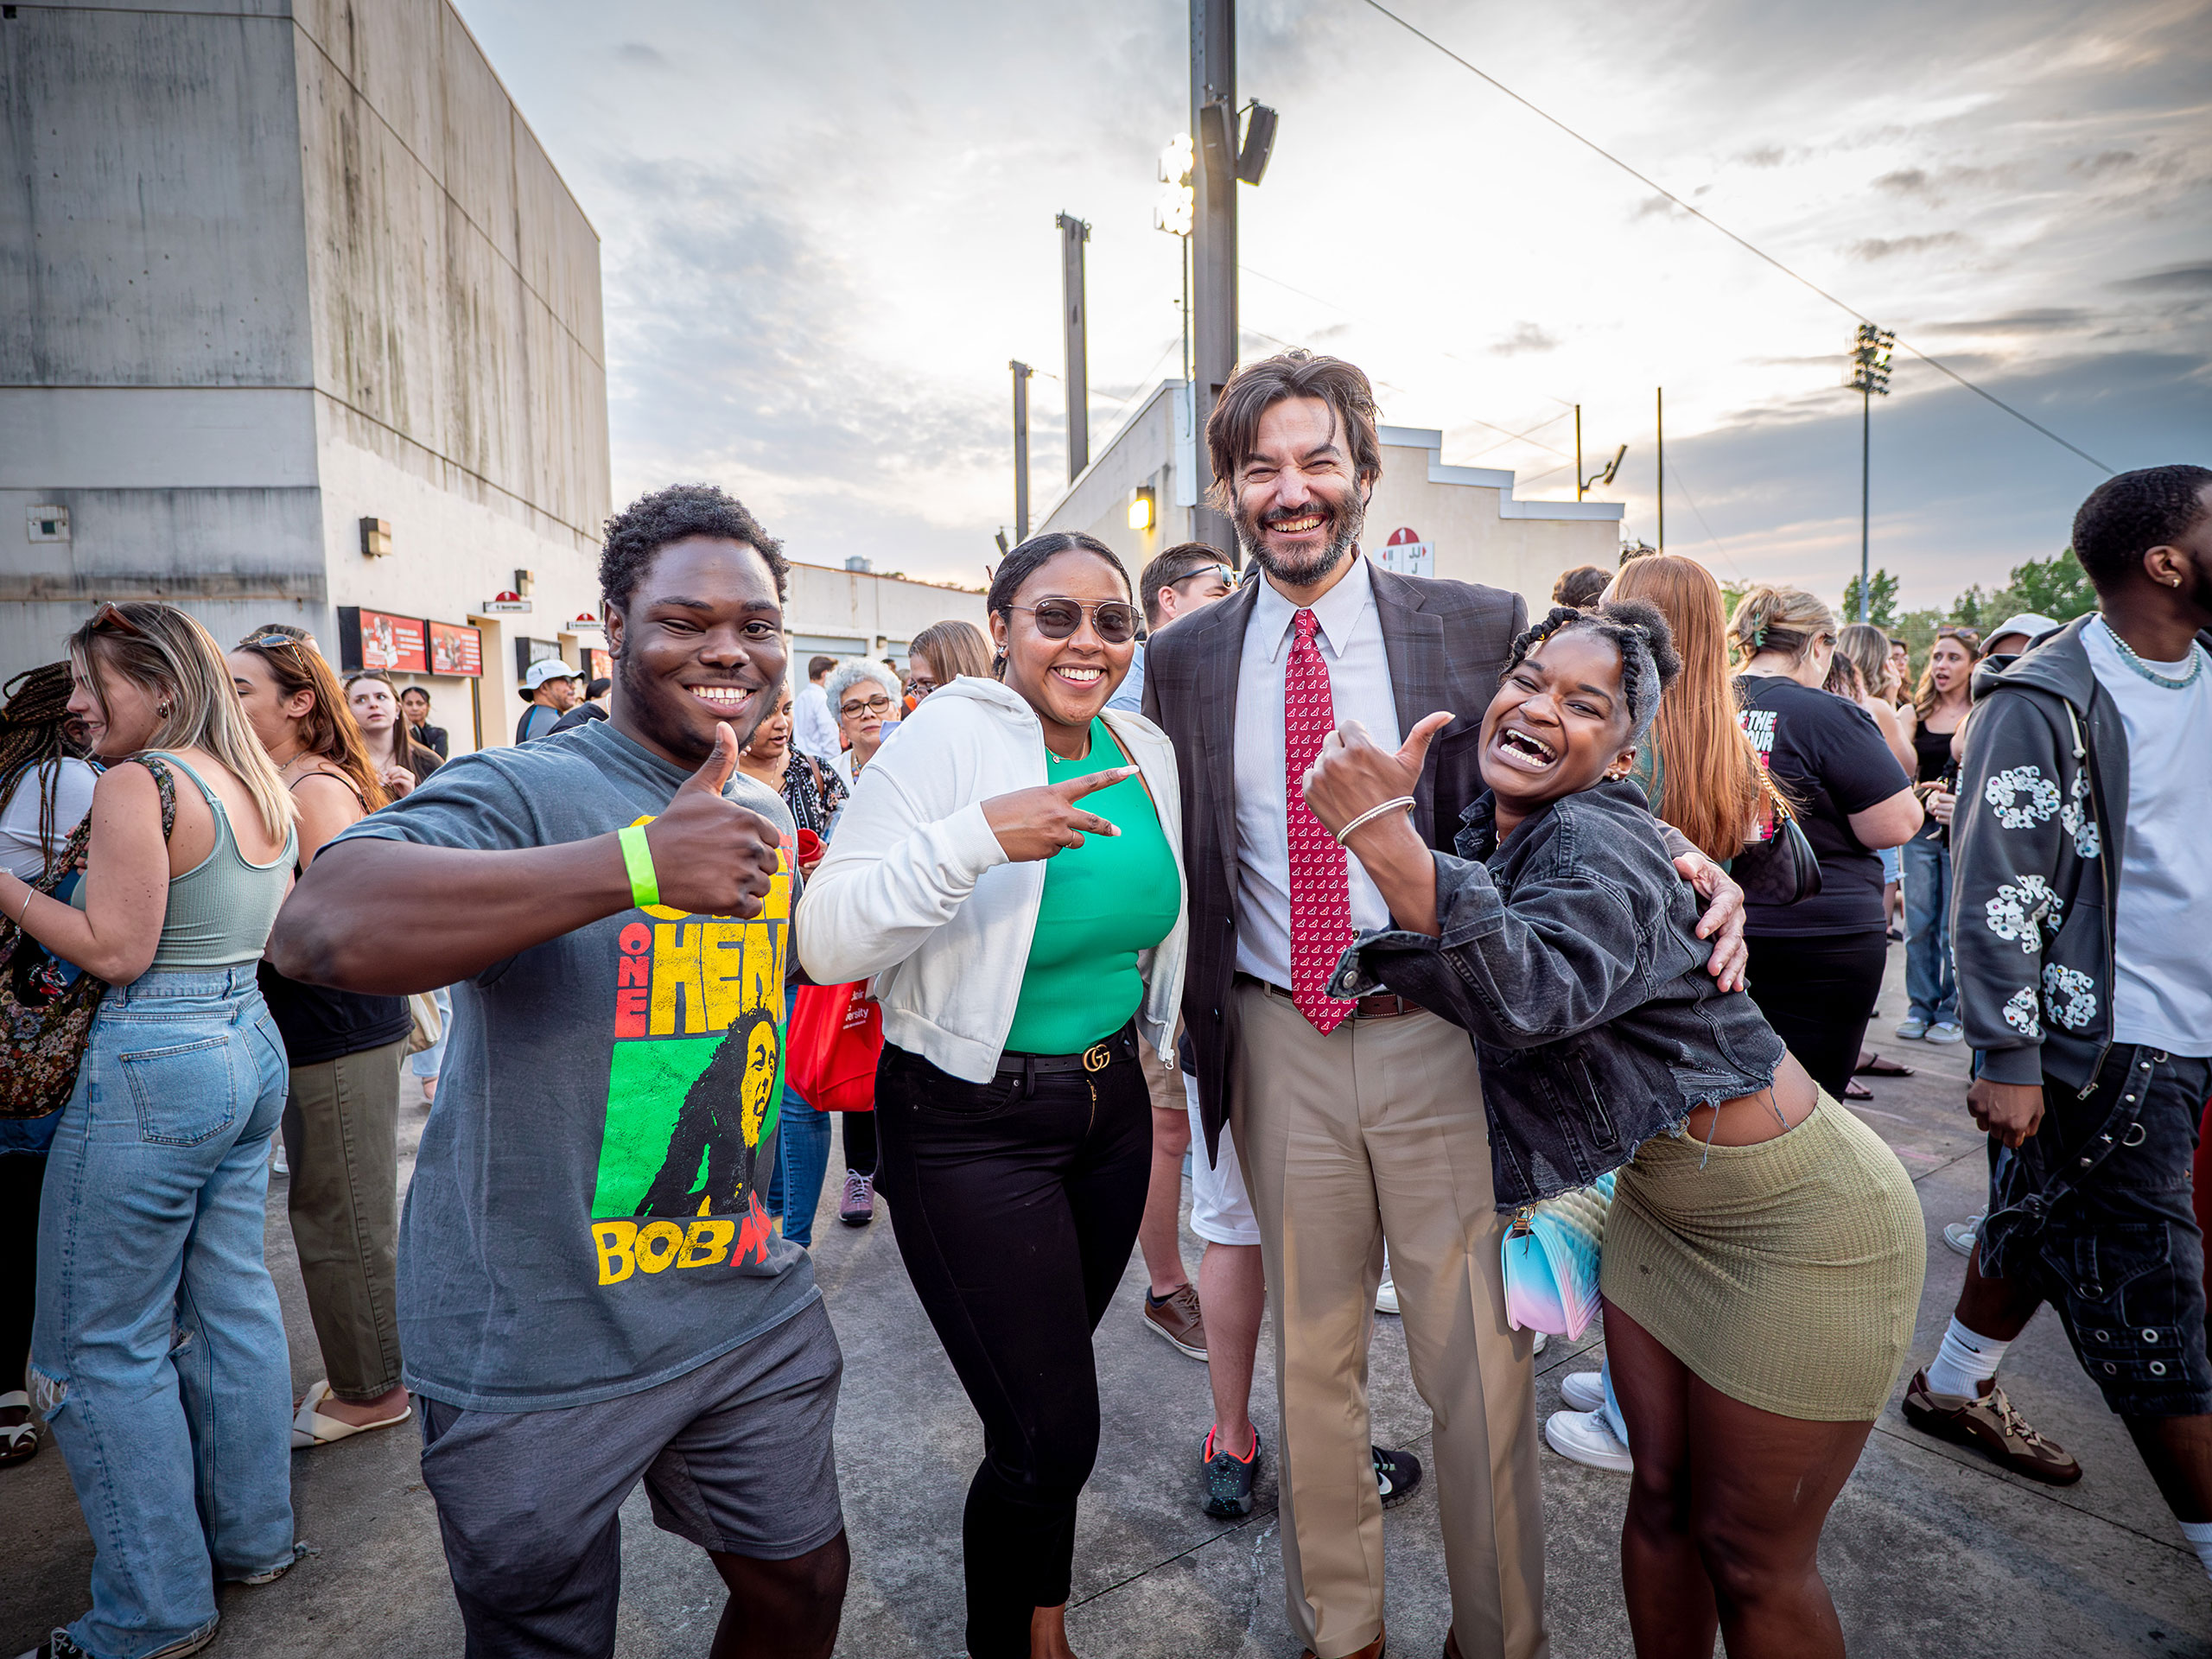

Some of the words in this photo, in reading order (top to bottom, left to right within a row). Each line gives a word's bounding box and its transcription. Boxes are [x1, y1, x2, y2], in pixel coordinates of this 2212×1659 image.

[1408, 546, 1421, 559] JJ
[1747, 709, 1778, 732] THE
[1742, 729, 1775, 753] OUR
[614, 922, 652, 1038] ONE
[591, 1220, 735, 1286] BOB
